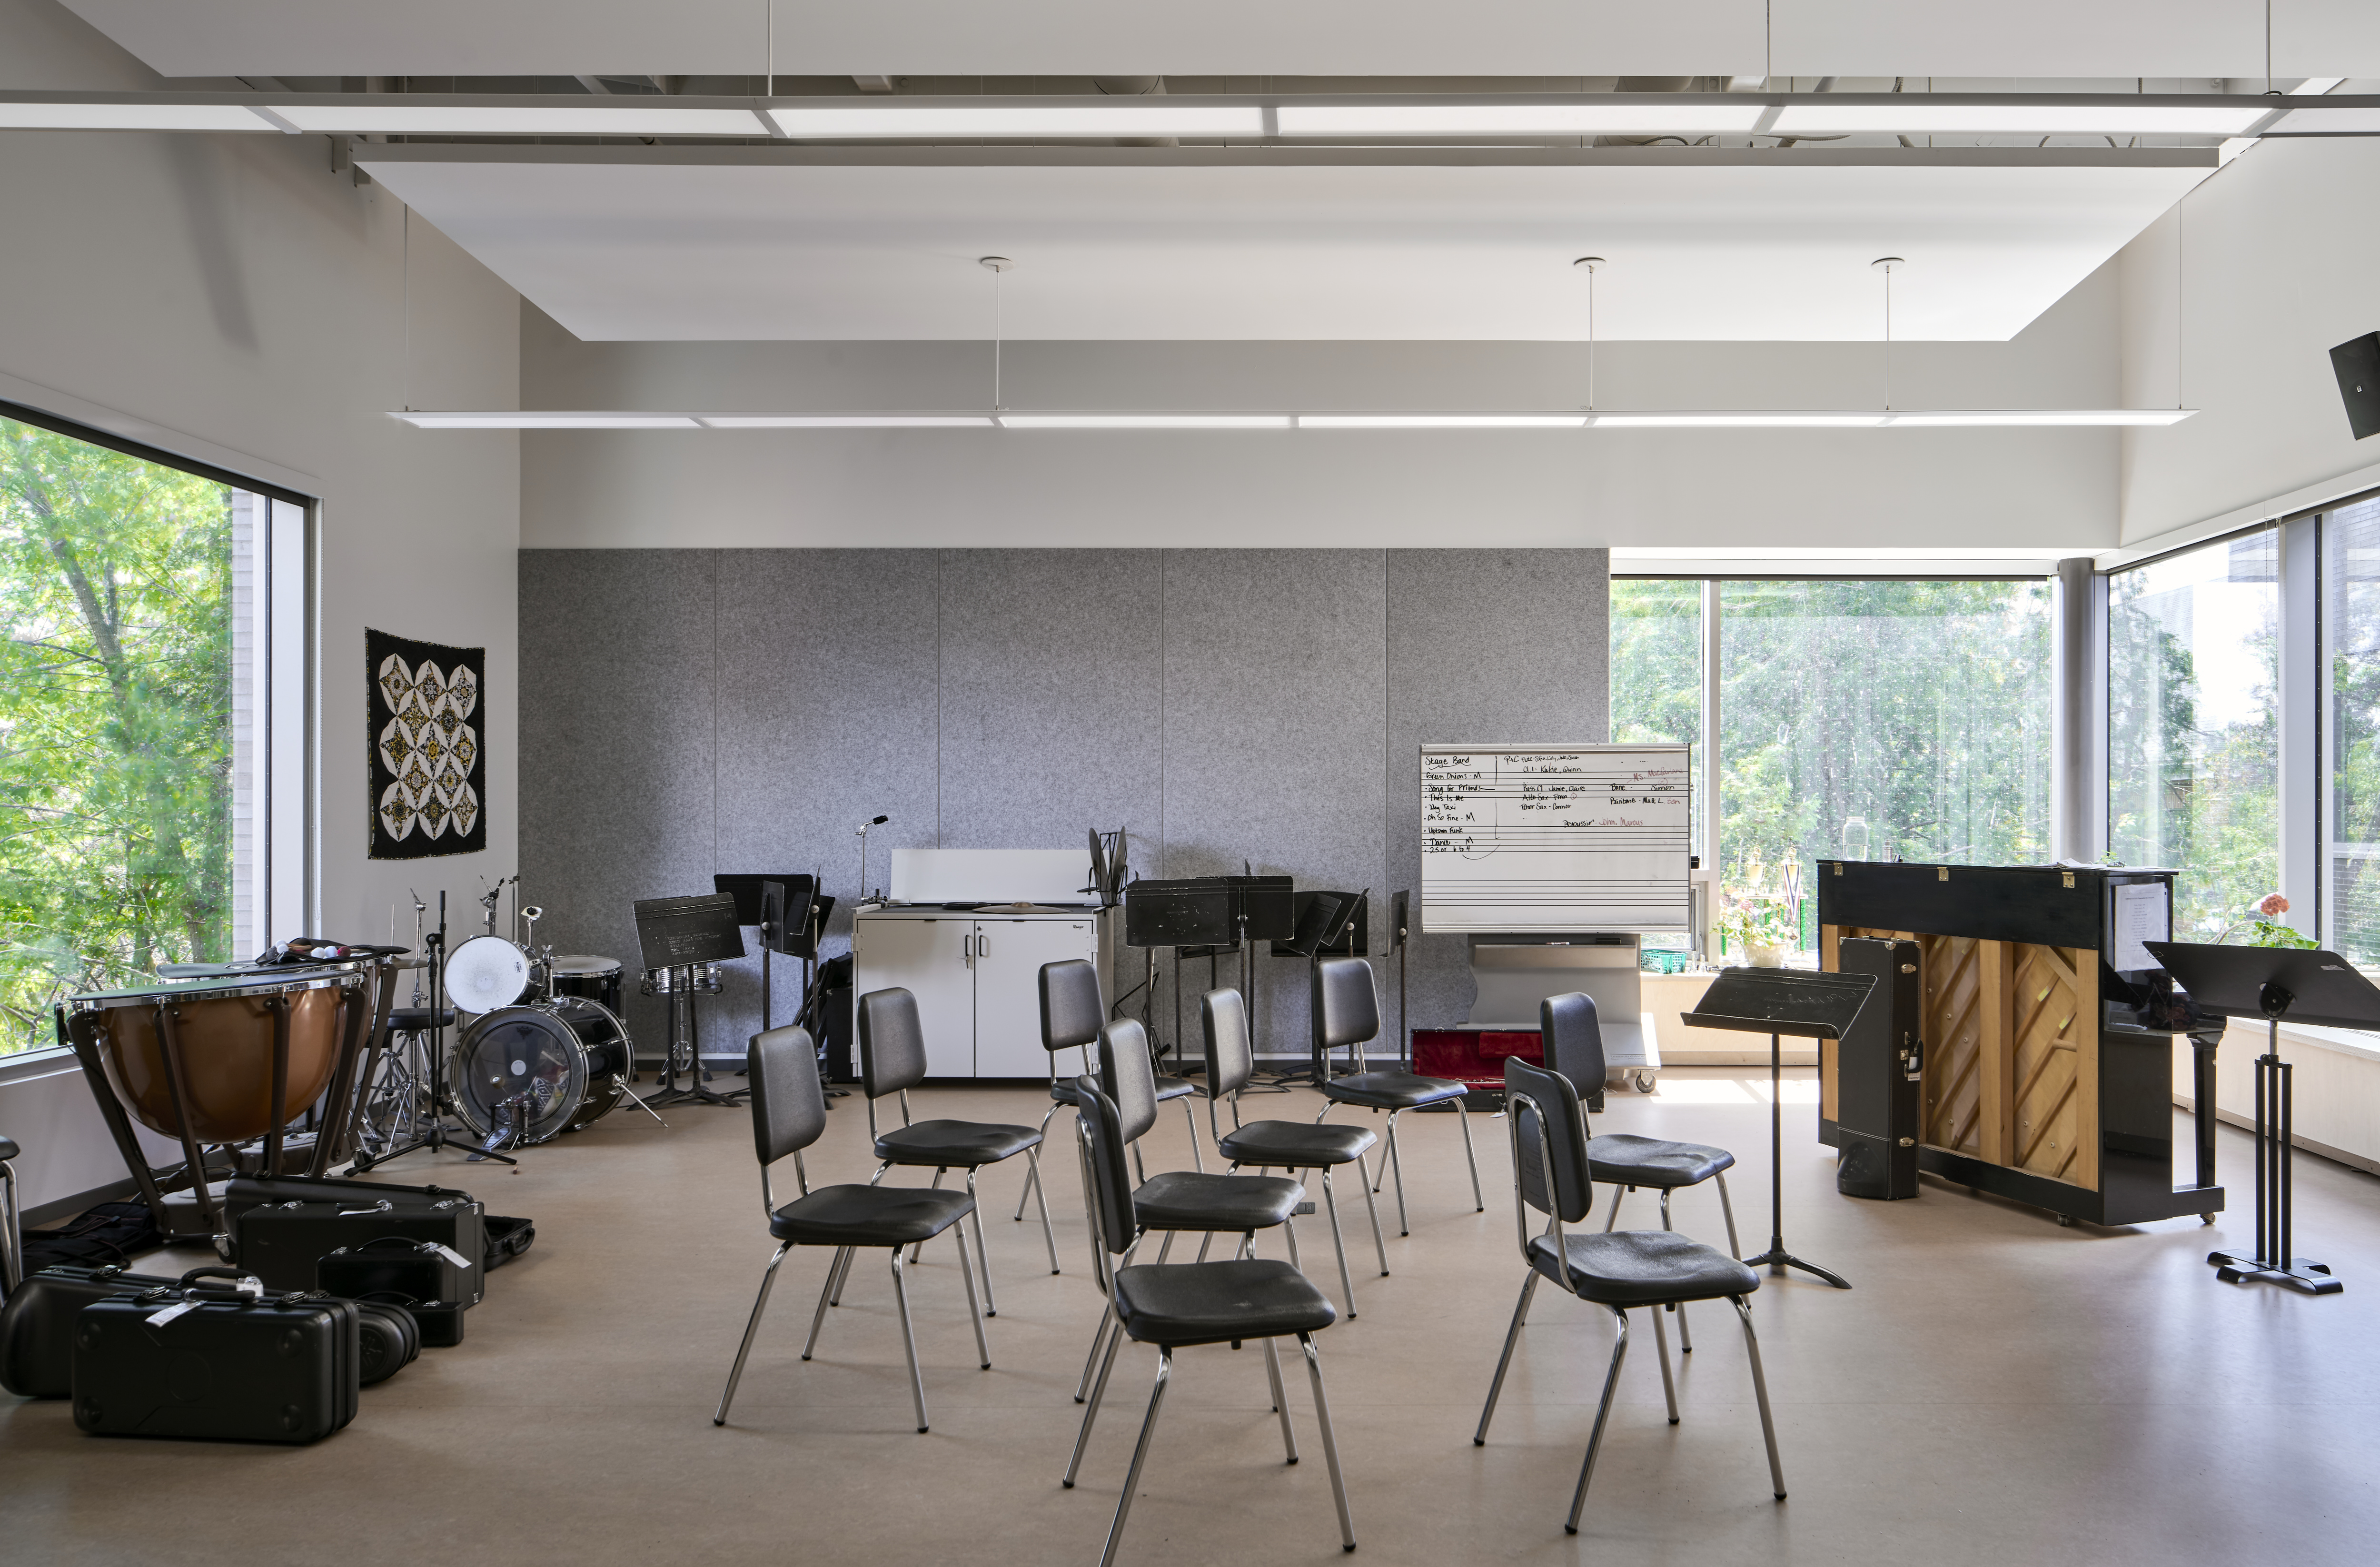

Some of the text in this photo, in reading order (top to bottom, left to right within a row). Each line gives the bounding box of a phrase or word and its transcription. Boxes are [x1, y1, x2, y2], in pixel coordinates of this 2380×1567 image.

[1426, 756, 1469, 768] Stage Band
[1428, 784, 1443, 795] Song
[1428, 793, 1444, 801] This
[1428, 803, 1440, 813] Hey
[1466, 812, 1475, 822] M
[1620, 817, 1643, 826] Marcus
[1428, 827, 1447, 835] Uptown
[1429, 836, 1473, 846] Dance M
